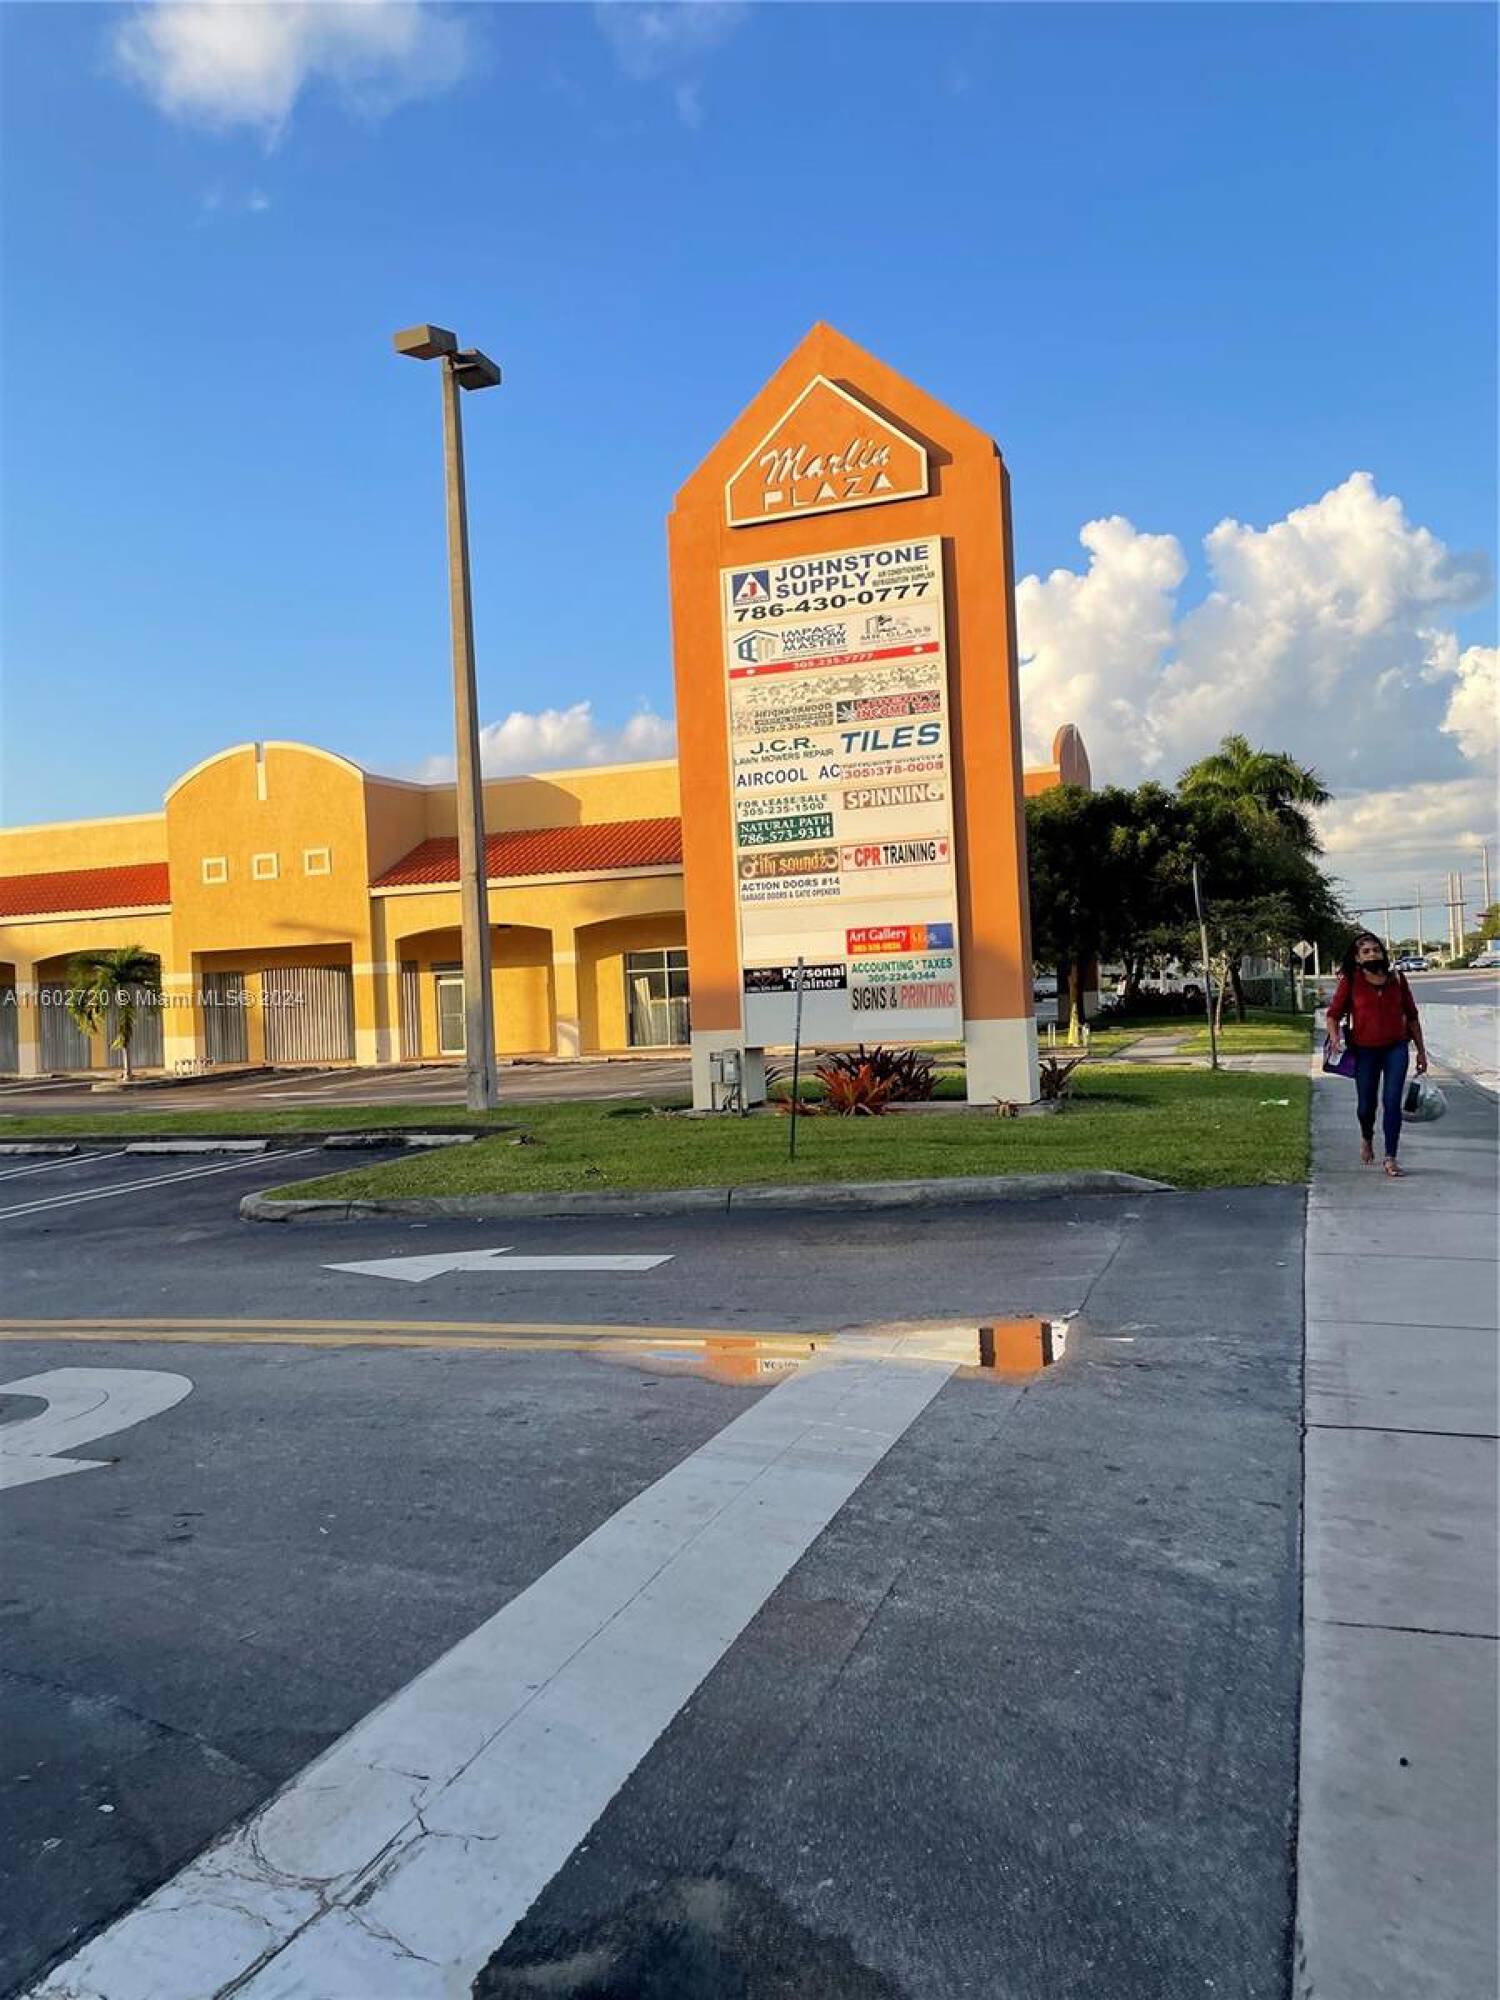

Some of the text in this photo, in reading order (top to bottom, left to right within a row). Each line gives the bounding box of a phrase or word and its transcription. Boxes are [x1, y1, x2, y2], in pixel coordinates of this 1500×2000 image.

[761, 438, 890, 484] Marlin
[763, 472, 894, 512] PLAZA
[776, 545, 929, 582] JOHNSTONE
[776, 571, 870, 599] SUPPLY
[734, 582, 929, 622] 786-430-0777
[781, 622, 846, 638] IMPACT
[782, 637, 846, 652] MASTER
[750, 737, 816, 755] J.C.R.
[841, 723, 941, 754] TILES
[761, 751, 800, 763] MOWERS
[803, 748, 834, 759] REPAIR
[737, 764, 841, 788] AIRCOOL AC
[738, 800, 759, 810] FOR
[845, 783, 942, 809] SPINNING
[740, 814, 830, 833] NATURAL PATH
[740, 825, 830, 846] 786-573-9314
[854, 842, 936, 867] CPR TRAINING
[741, 881, 780, 892] ACTION
[783, 878, 818, 889] DOORS
[850, 930, 866, 943] Art
[869, 928, 908, 942] Gallery
[851, 958, 952, 973] ACCOUNTING TAXES
[852, 982, 955, 1010] SIGNS & PRINTING
